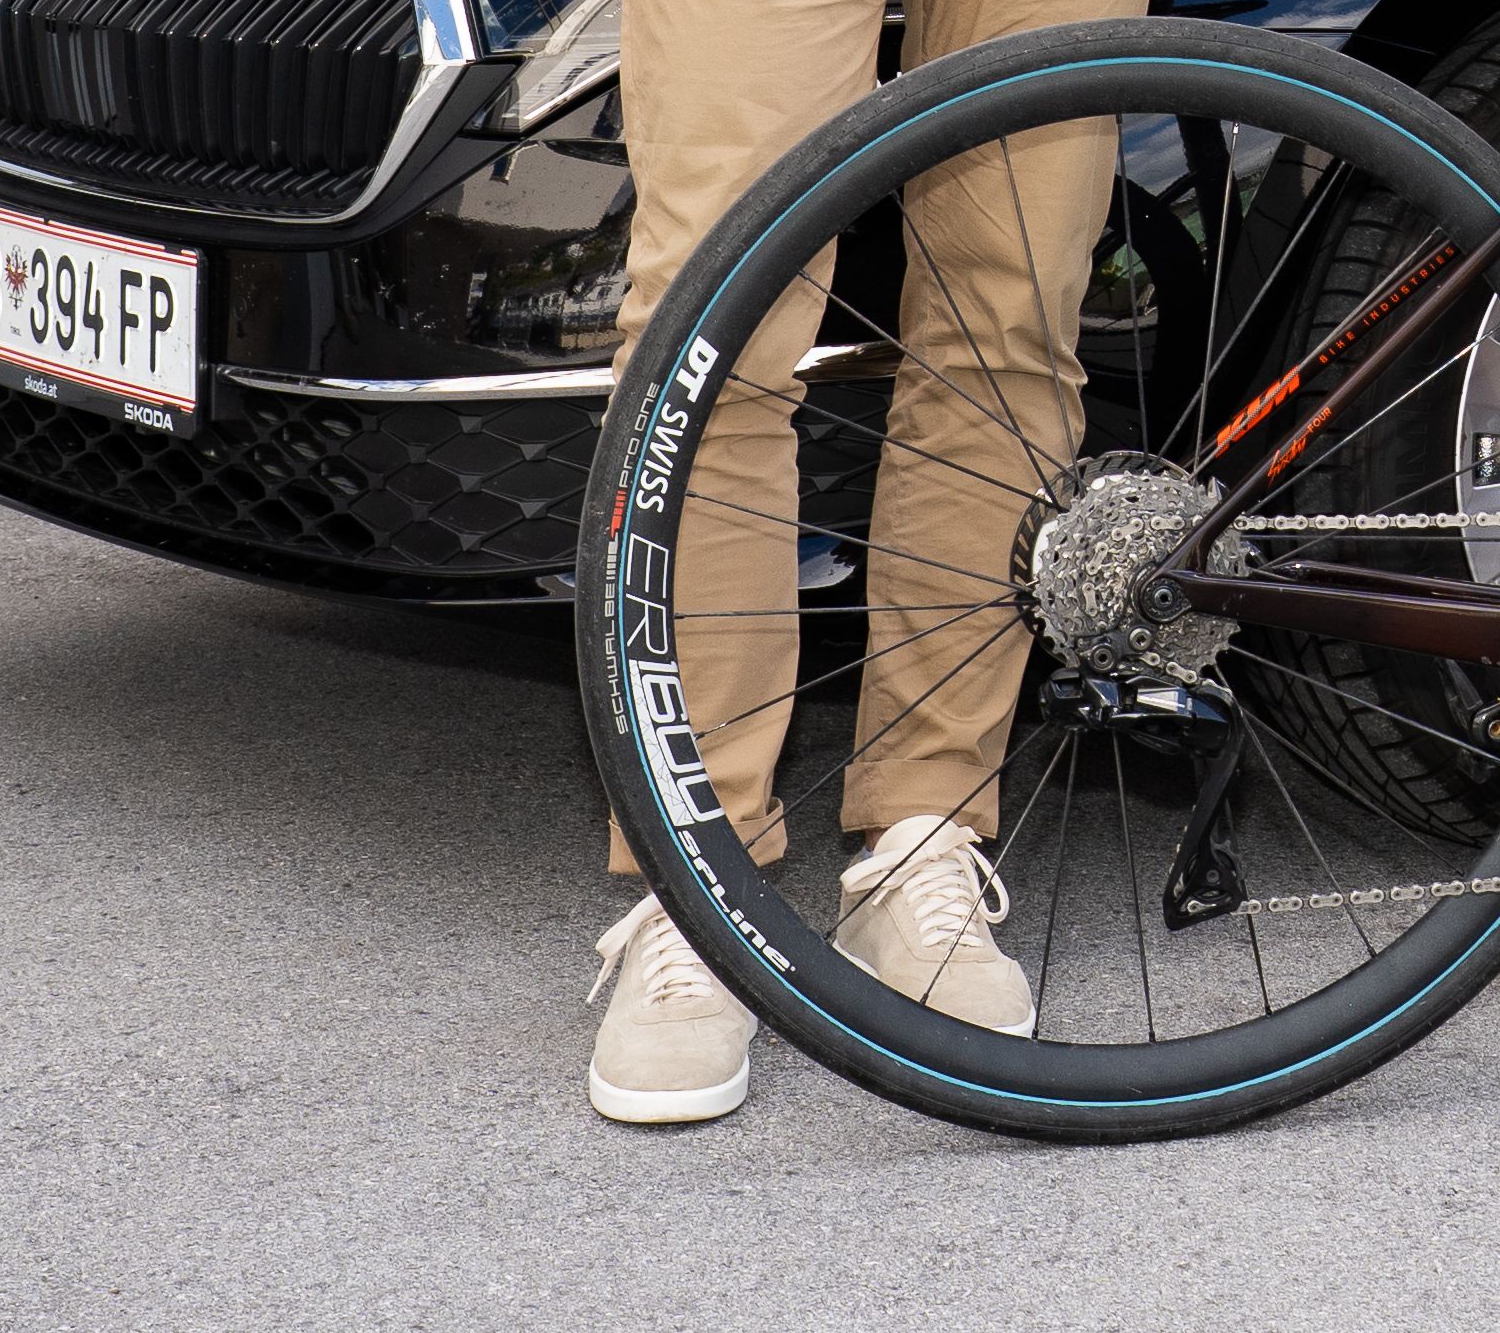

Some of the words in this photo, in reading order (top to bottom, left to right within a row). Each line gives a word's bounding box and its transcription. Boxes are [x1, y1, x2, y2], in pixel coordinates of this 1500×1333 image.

[30, 248, 105, 361] 394
[120, 268, 175, 374] FP
[1318, 330, 1357, 365] BIKE
[1362, 244, 1457, 327] INDUSTRIES
[674, 334, 720, 403] DT
[636, 405, 689, 514] SWISS
[604, 580, 629, 737] SCHWALBE
